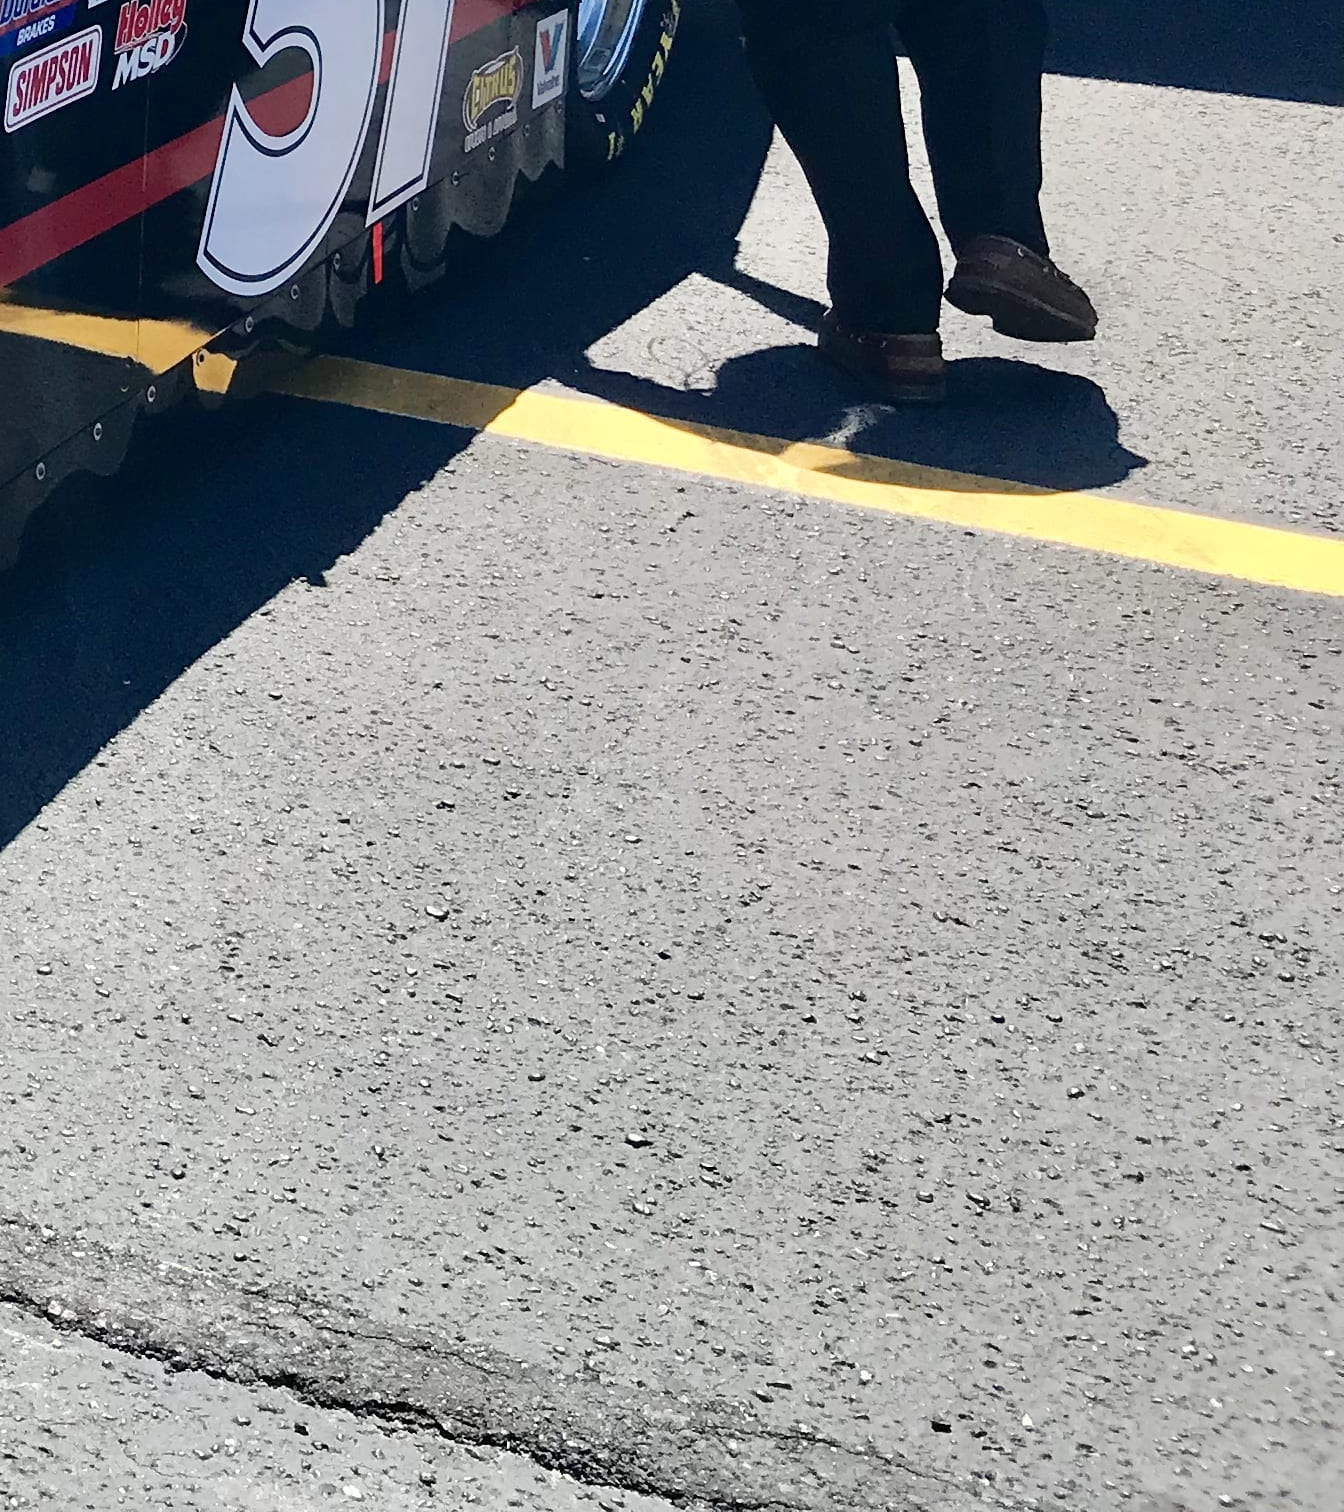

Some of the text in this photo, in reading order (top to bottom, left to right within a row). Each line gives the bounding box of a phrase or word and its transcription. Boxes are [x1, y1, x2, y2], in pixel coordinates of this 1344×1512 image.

[16, 14, 56, 46] BRAKES
[12, 39, 93, 117] SIMPSON
[111, 34, 176, 91] MSD
[470, 54, 518, 120] CITRUS
